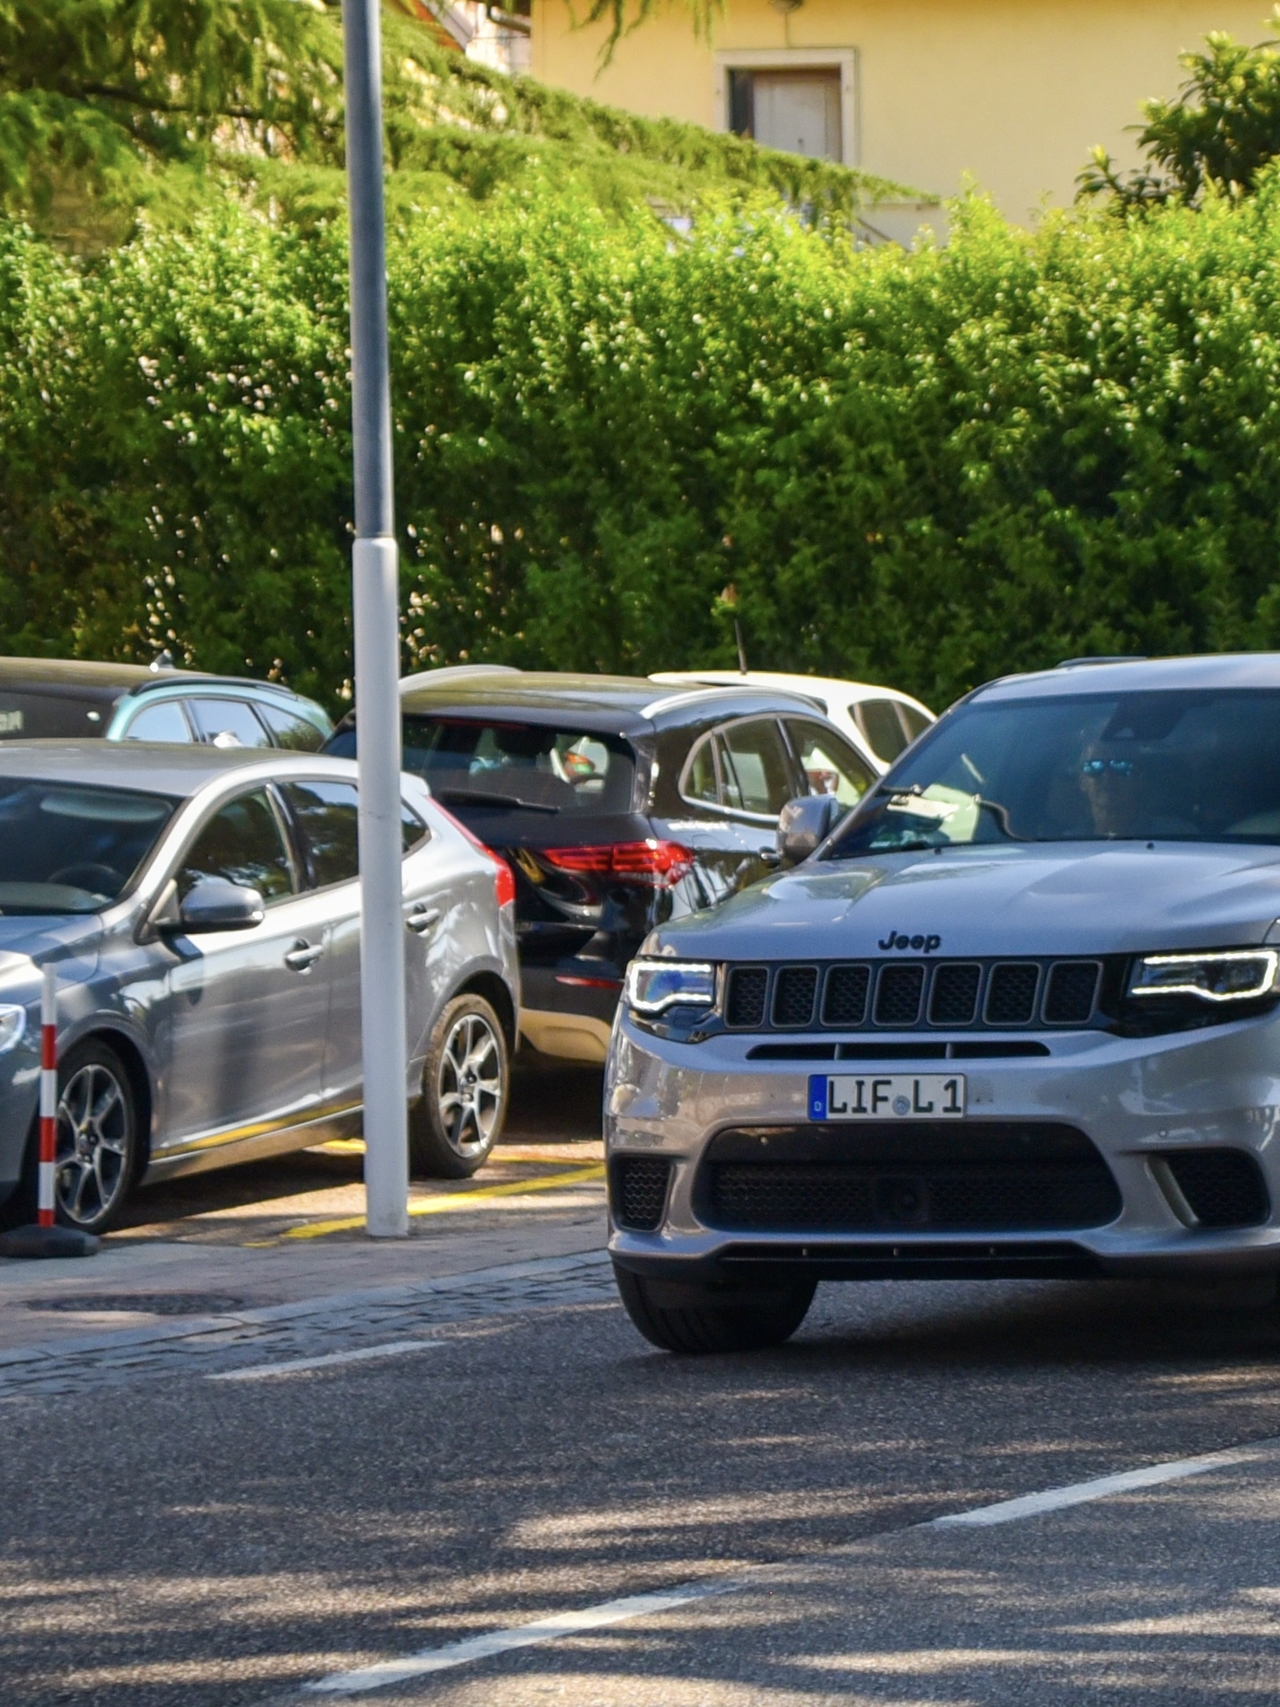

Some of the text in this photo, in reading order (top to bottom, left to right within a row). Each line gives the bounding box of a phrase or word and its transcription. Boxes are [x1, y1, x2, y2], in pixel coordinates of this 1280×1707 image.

[878, 931, 941, 953] Jeep
[814, 1101, 822, 1112] D
[828, 1080, 892, 1114] LIF
